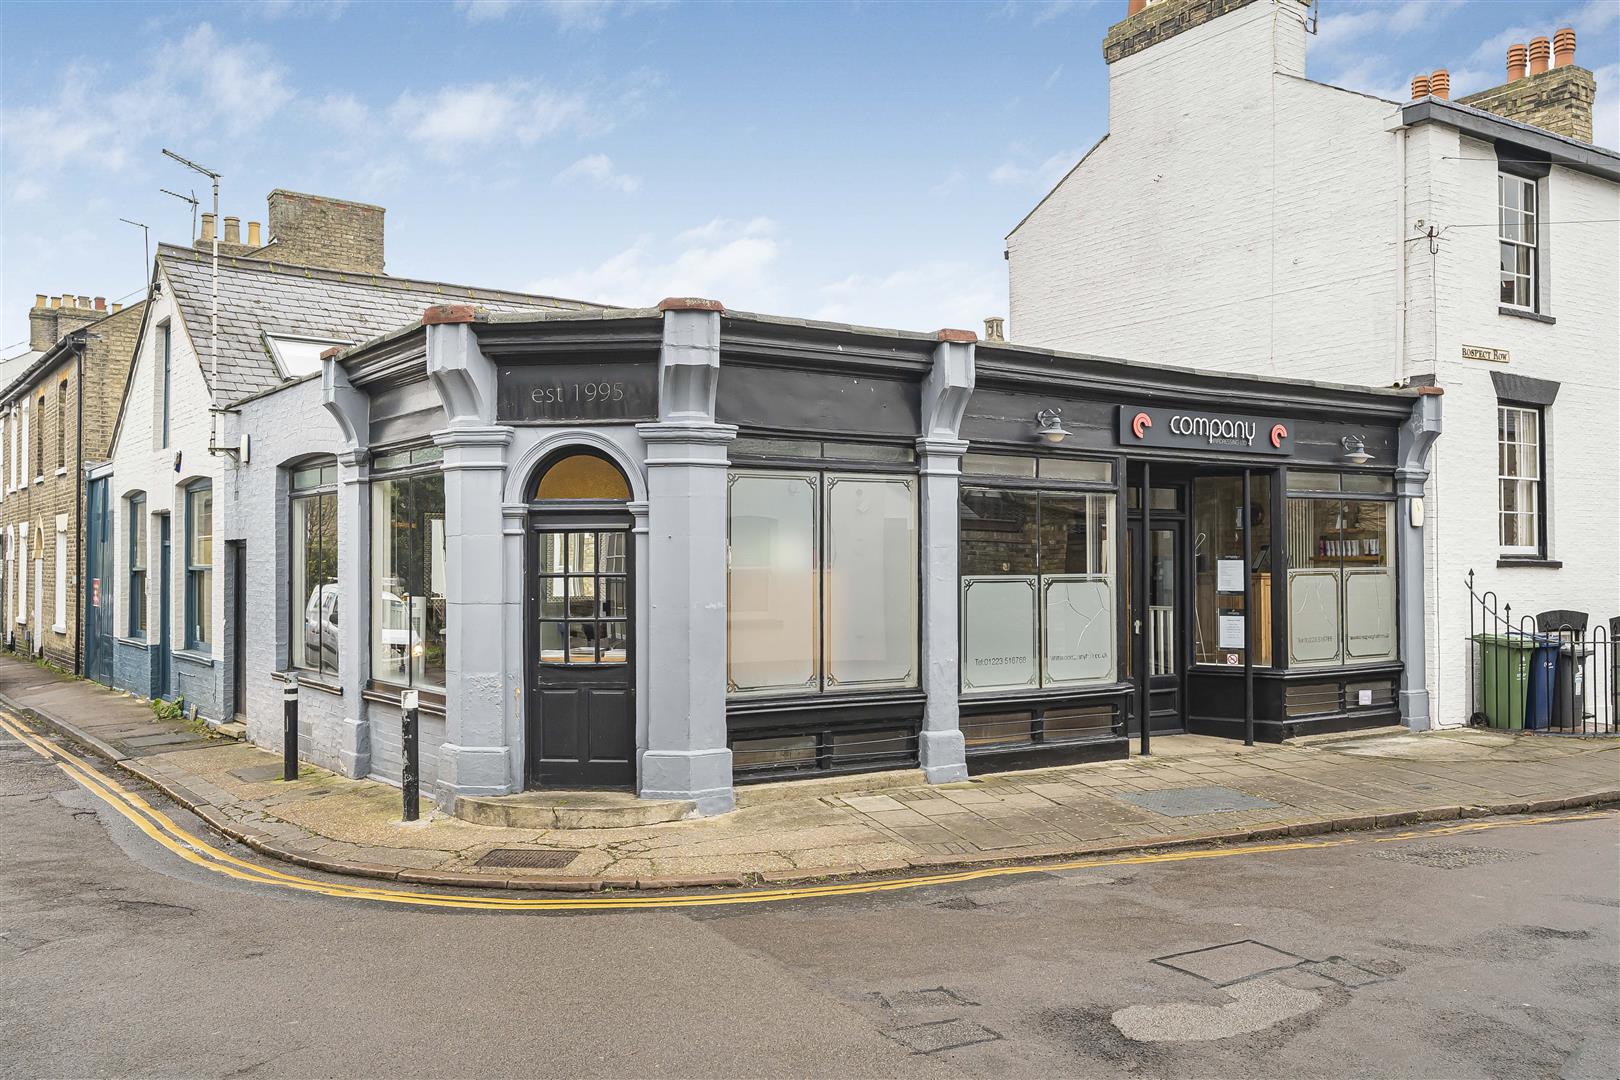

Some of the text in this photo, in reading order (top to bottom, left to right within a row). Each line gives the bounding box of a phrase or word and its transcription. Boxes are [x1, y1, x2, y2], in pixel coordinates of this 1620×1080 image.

[531, 382, 624, 403] est 1995
[1170, 415, 1256, 446] company
